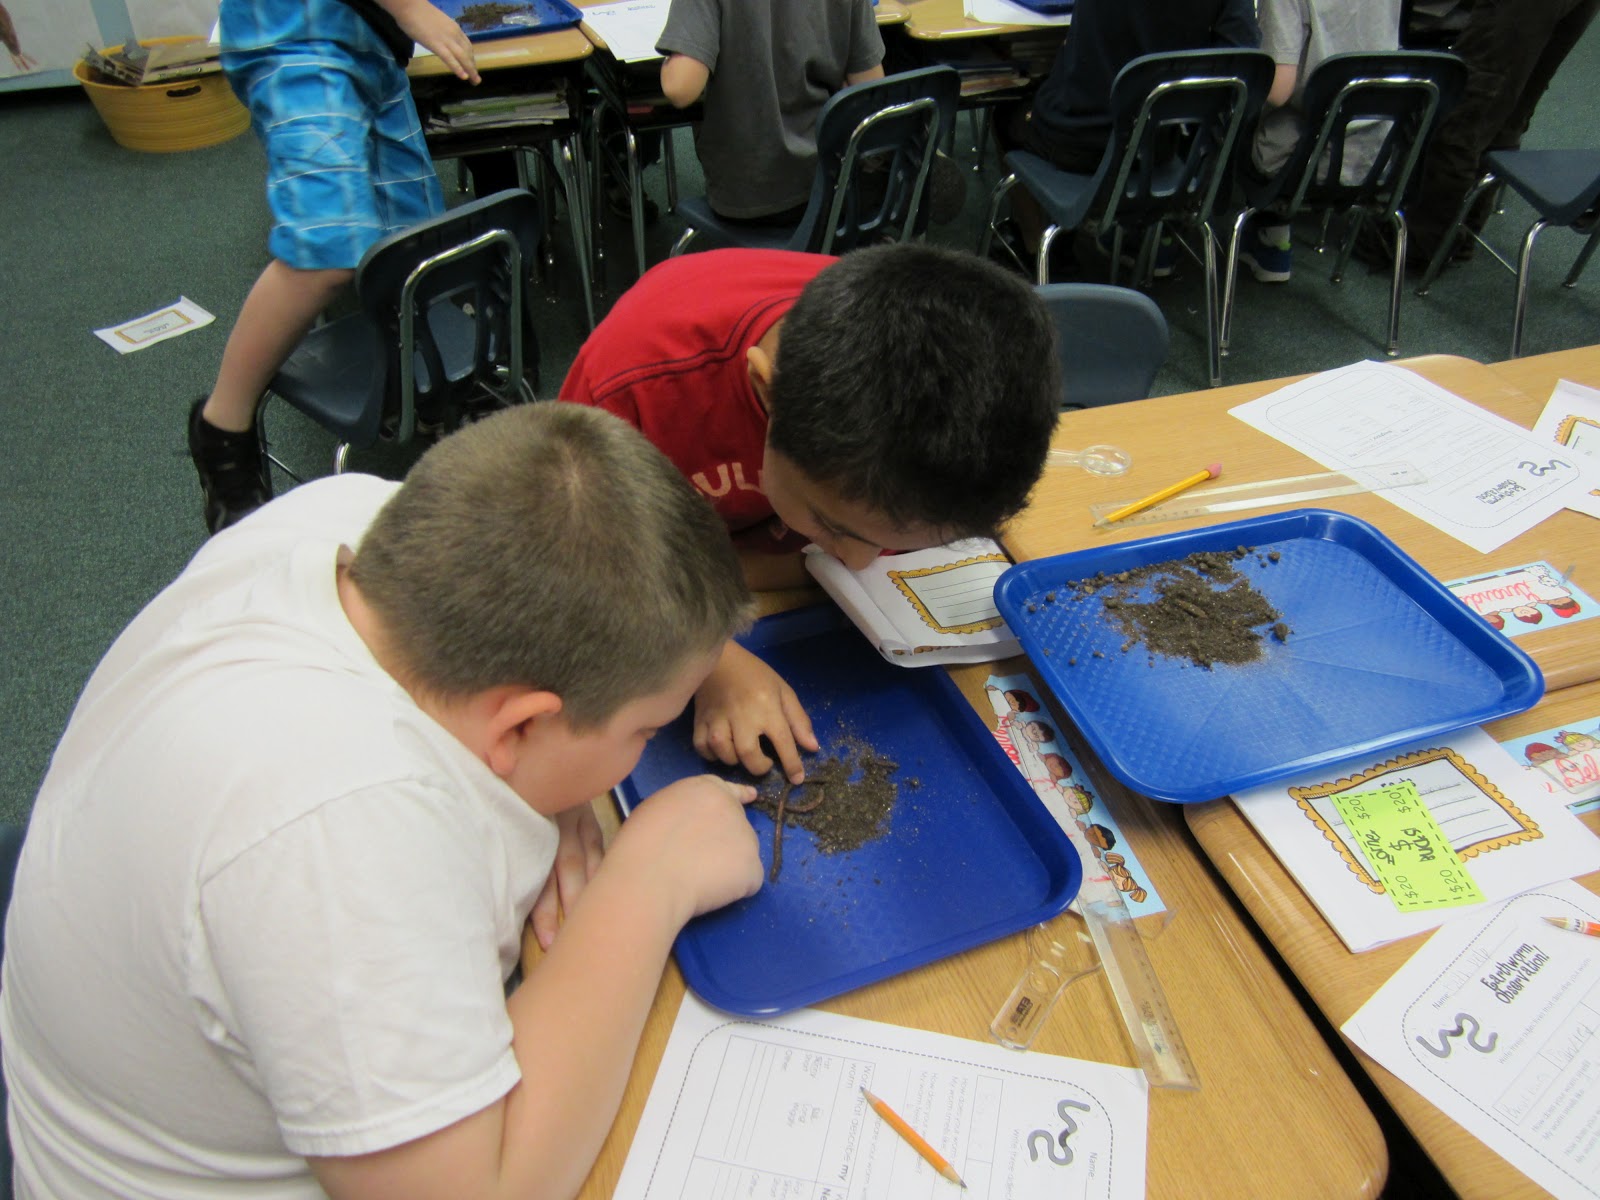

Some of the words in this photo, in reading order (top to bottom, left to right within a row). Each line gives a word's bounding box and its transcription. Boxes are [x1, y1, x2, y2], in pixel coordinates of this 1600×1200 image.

[1349, 796, 1370, 821] $20
[1389, 790, 1410, 814] $20
[1395, 873, 1417, 900] $20
[1439, 866, 1463, 894] $20
[1479, 941, 1534, 990] Earthworm
[1494, 944, 1550, 1003] Observation!
[845, 1063, 857, 1089] worm
[842, 1118, 859, 1161] describe
[837, 1163, 849, 1181] my
